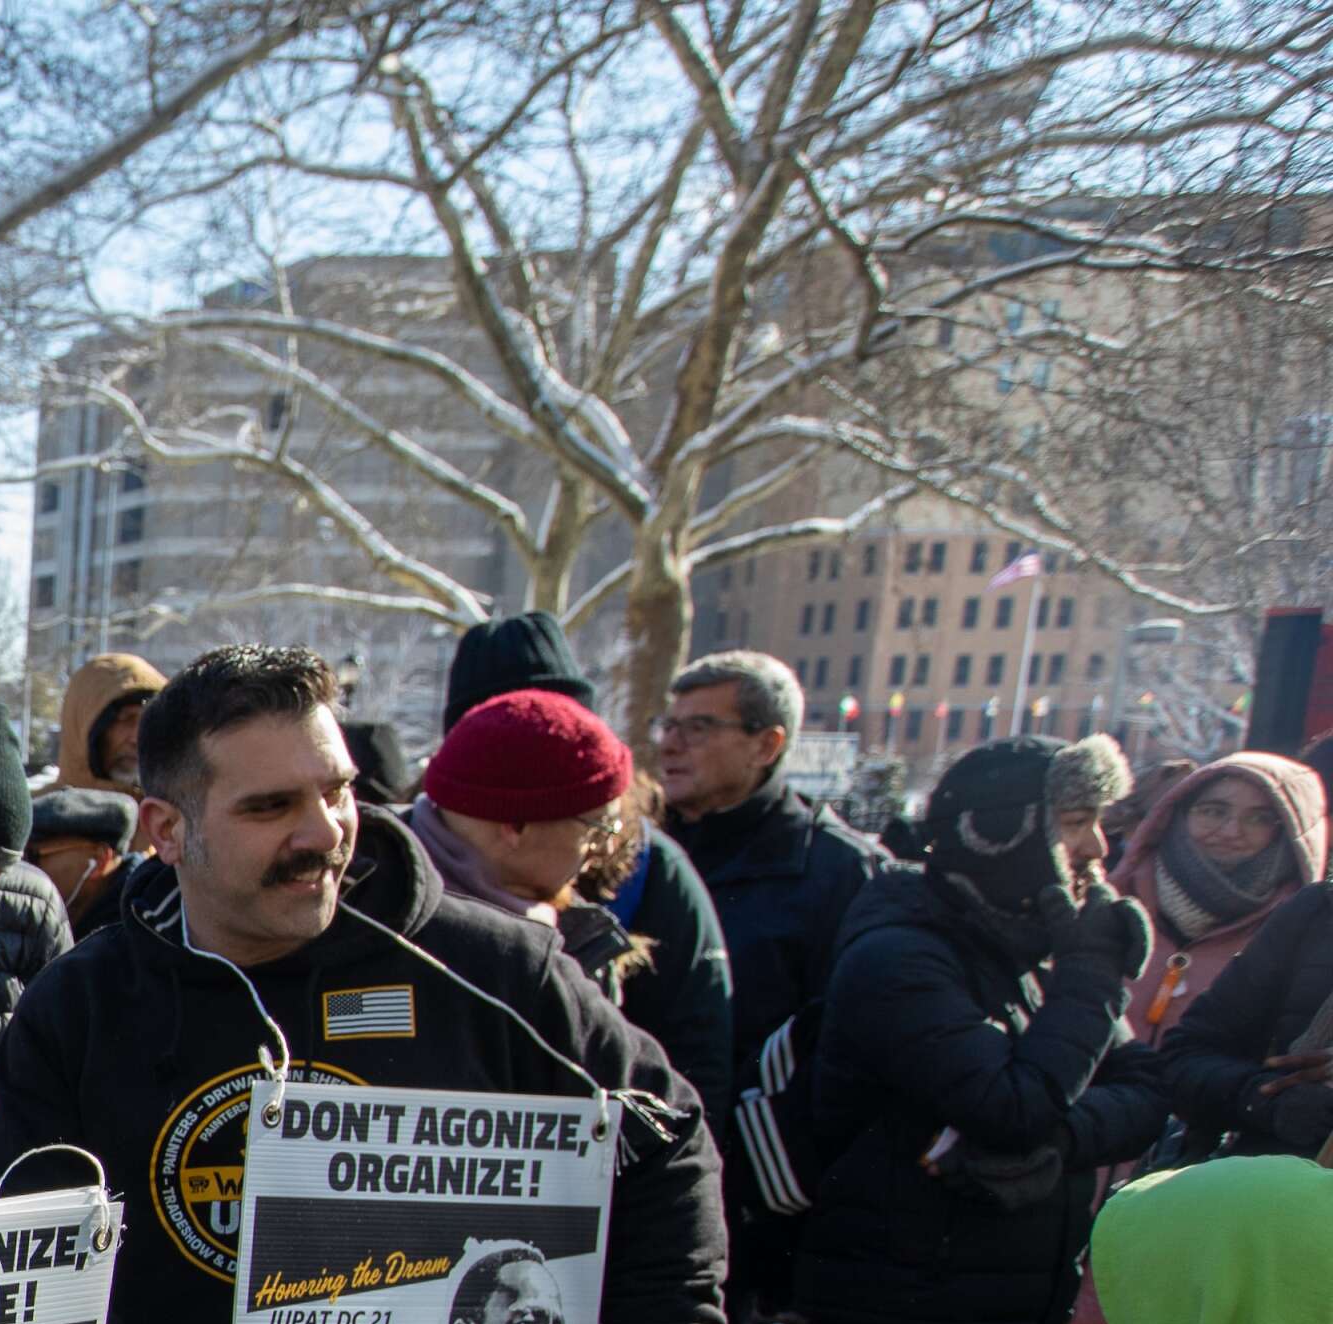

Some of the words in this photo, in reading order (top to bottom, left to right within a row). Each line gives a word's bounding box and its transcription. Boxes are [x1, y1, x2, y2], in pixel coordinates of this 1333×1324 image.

[162, 1110, 198, 1175] PAINTERS
[199, 1101, 249, 1141] PAINTERS
[281, 1100, 406, 1144] DON'T
[412, 1108, 589, 1157] AGONIZE,
[328, 1152, 541, 1197] ORGANIZE!
[162, 1187, 215, 1260] TRADESHOW
[212, 1252, 225, 1267] &
[256, 1266, 347, 1307] Honoring
[352, 1257, 381, 1287] the
[385, 1250, 450, 1285] Dream
